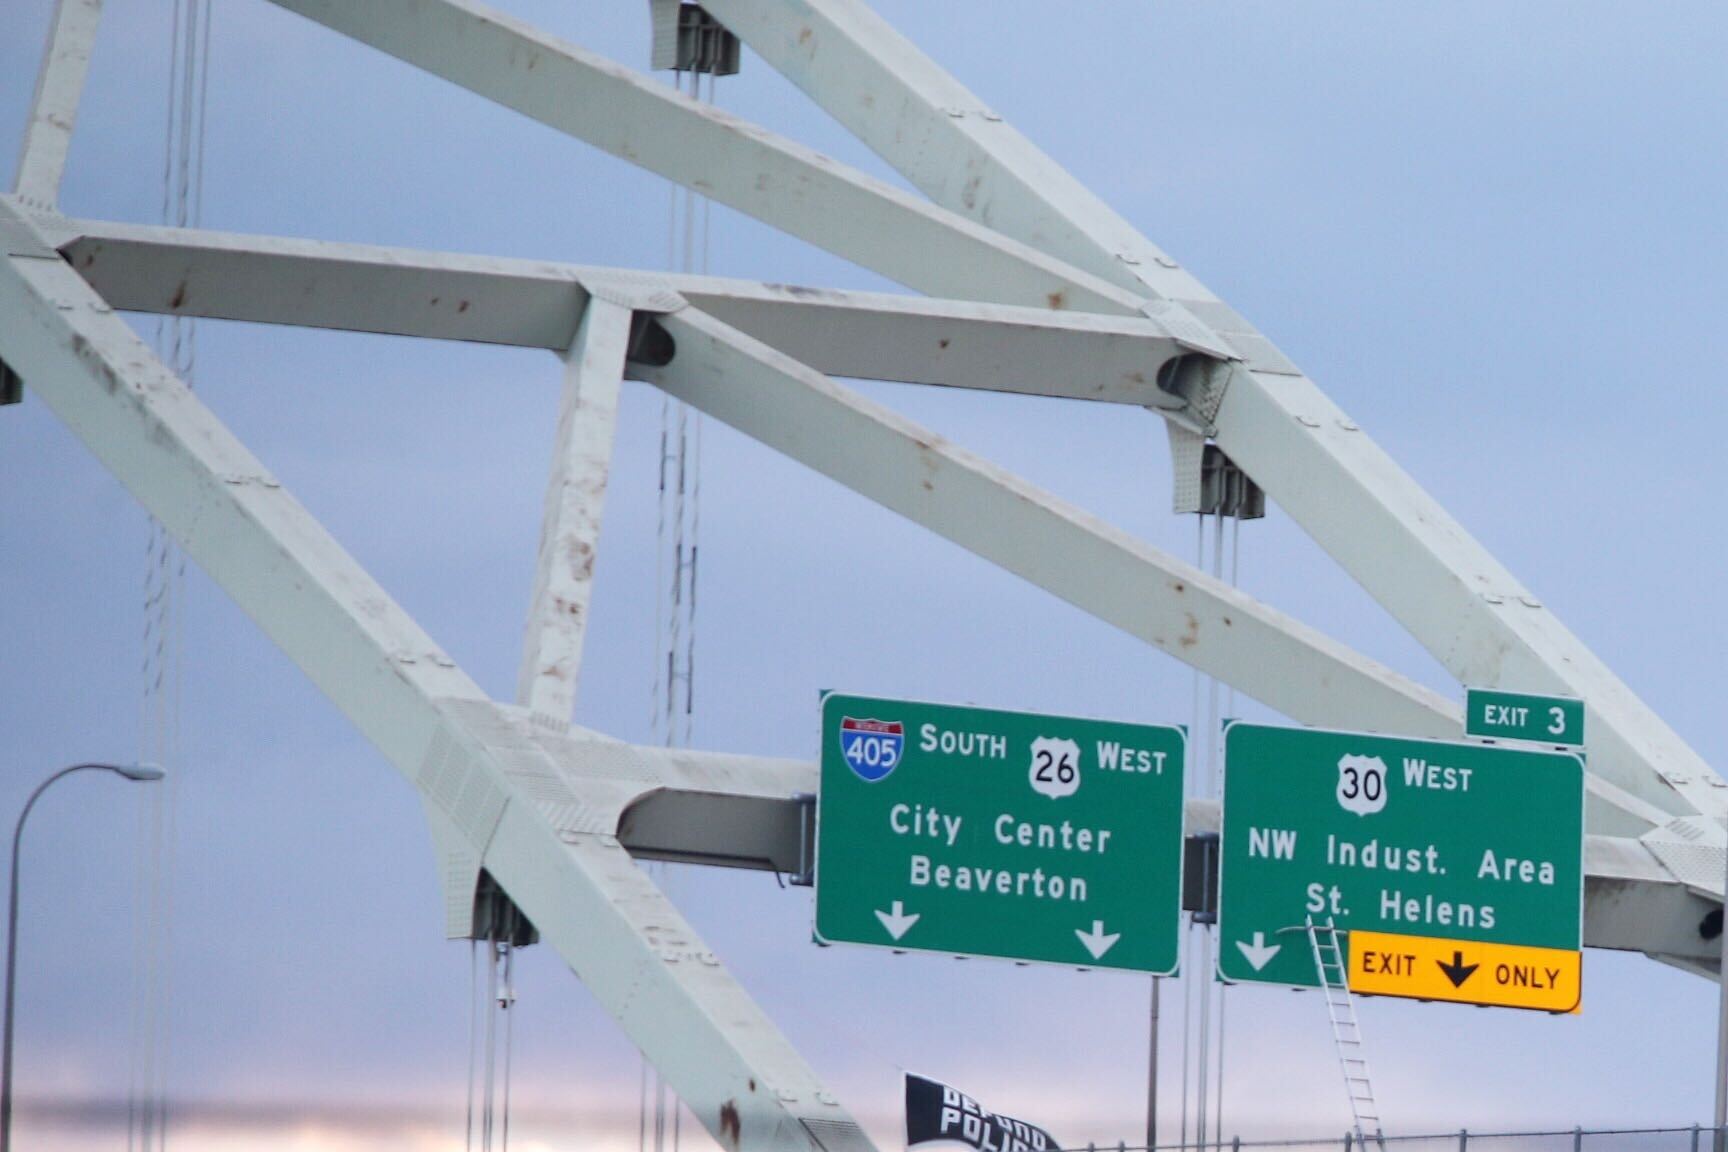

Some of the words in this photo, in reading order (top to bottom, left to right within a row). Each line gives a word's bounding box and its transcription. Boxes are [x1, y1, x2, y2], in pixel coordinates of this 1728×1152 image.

[1484, 705, 1529, 727] EXIT
[1547, 707, 1566, 734] 3
[847, 735, 897, 767] 405
[919, 723, 1006, 759] SOUTH
[1096, 741, 1167, 775] WEST
[1035, 750, 1075, 784] 26
[1342, 767, 1381, 801] 30
[1403, 757, 1472, 792] WEST
[890, 803, 962, 845] City
[994, 814, 1111, 853] Center
[1249, 827, 1297, 860] NW
[1327, 834, 1446, 875] Indust.
[1477, 850, 1555, 884] Area
[910, 855, 1087, 901] Beaverton
[1305, 882, 1350, 916] St.
[1380, 889, 1496, 930] Helens
[1363, 951, 1416, 977] EXIT
[1495, 964, 1560, 990] ONLY
